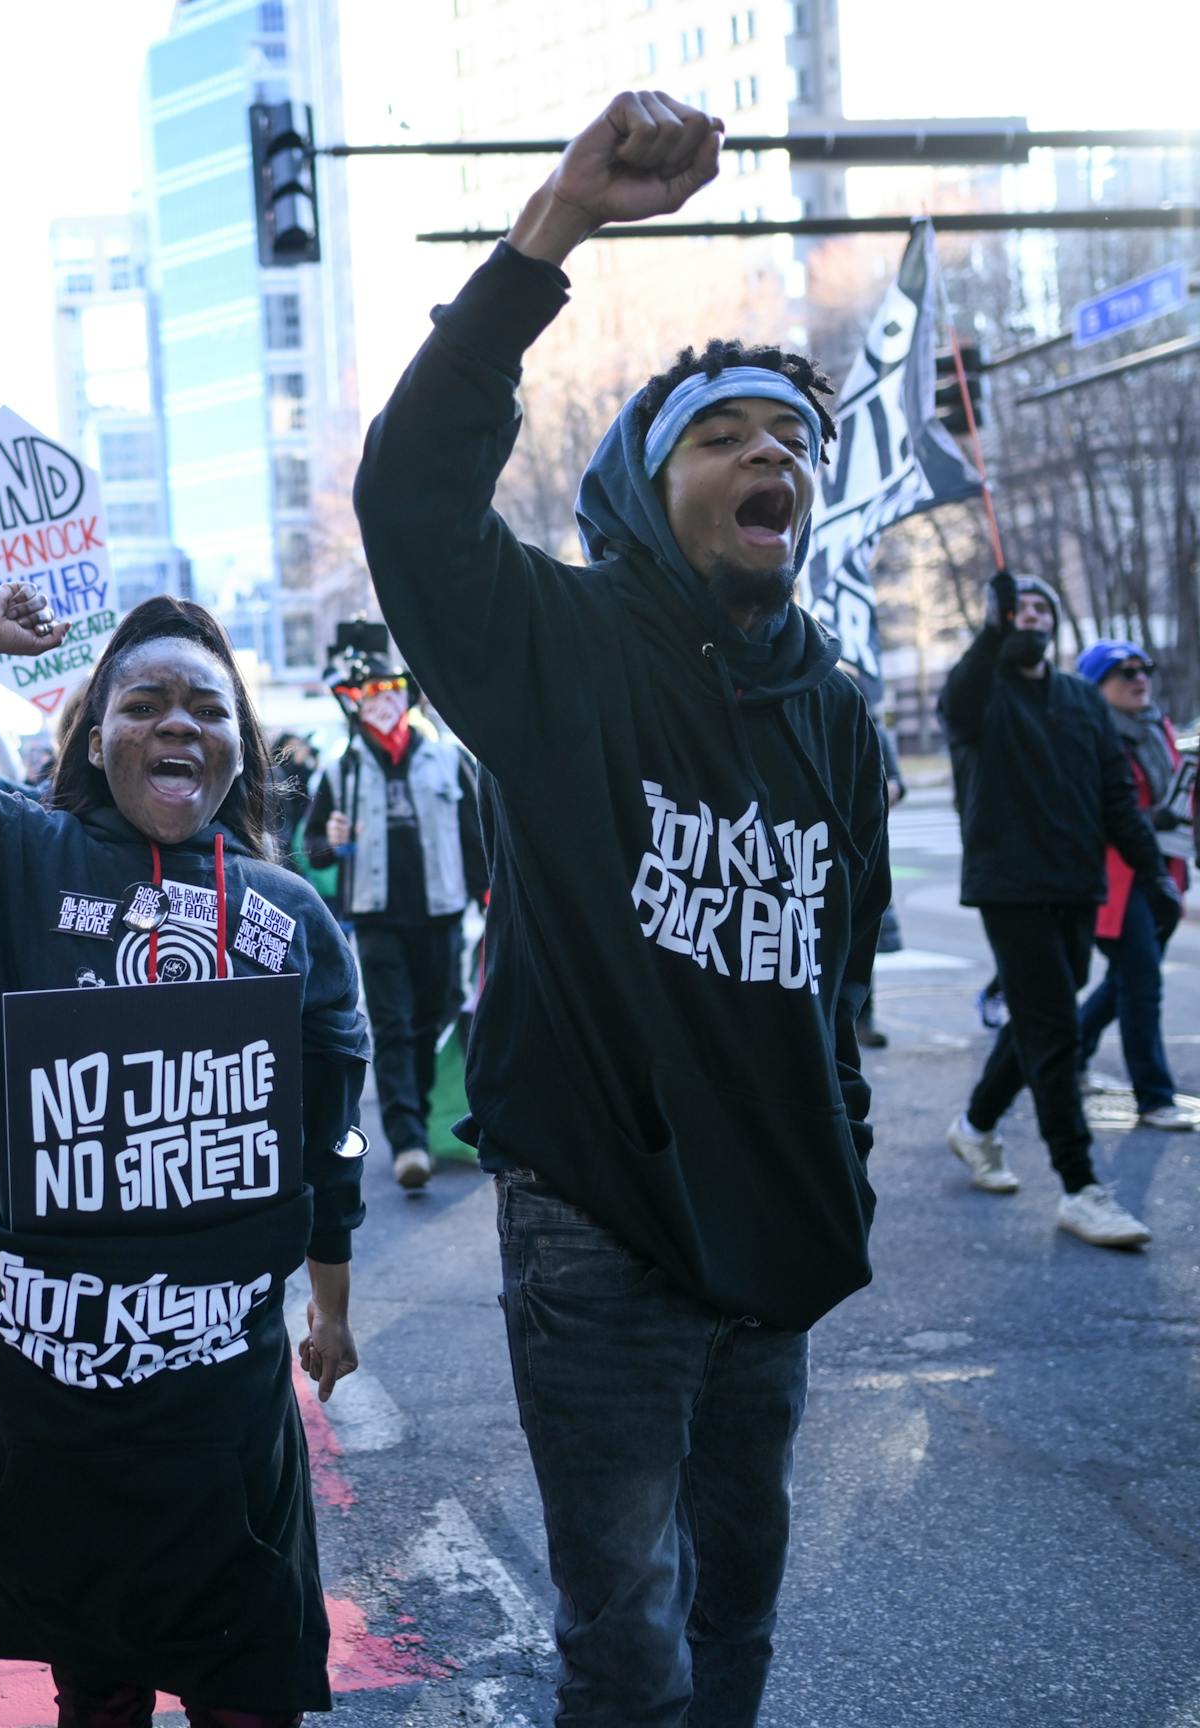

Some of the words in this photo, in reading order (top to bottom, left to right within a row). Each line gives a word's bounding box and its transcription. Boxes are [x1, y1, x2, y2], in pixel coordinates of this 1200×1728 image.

[12, 643, 94, 688] DANGER
[642, 779, 714, 879] TOP
[61, 897, 78, 912] ALL
[77, 899, 103, 916] POWER
[102, 903, 117, 919] TO
[135, 886, 165, 907] BLACK
[168, 886, 183, 900] ALL
[184, 889, 209, 906] POWER
[249, 894, 264, 911] NO
[129, 900, 158, 918] LIVES
[170, 899, 183, 916] THE
[185, 904, 218, 923] PEOPLE
[58, 911, 77, 930] THE
[75, 915, 112, 935] PEOPLE
[239, 919, 260, 940] STOP
[234, 933, 261, 960] BLACK
[258, 945, 284, 973] PEOPLE
[30, 1051, 109, 1143] NO
[36, 1140, 105, 1217] NO
[115, 1118, 280, 1212] STREETS
